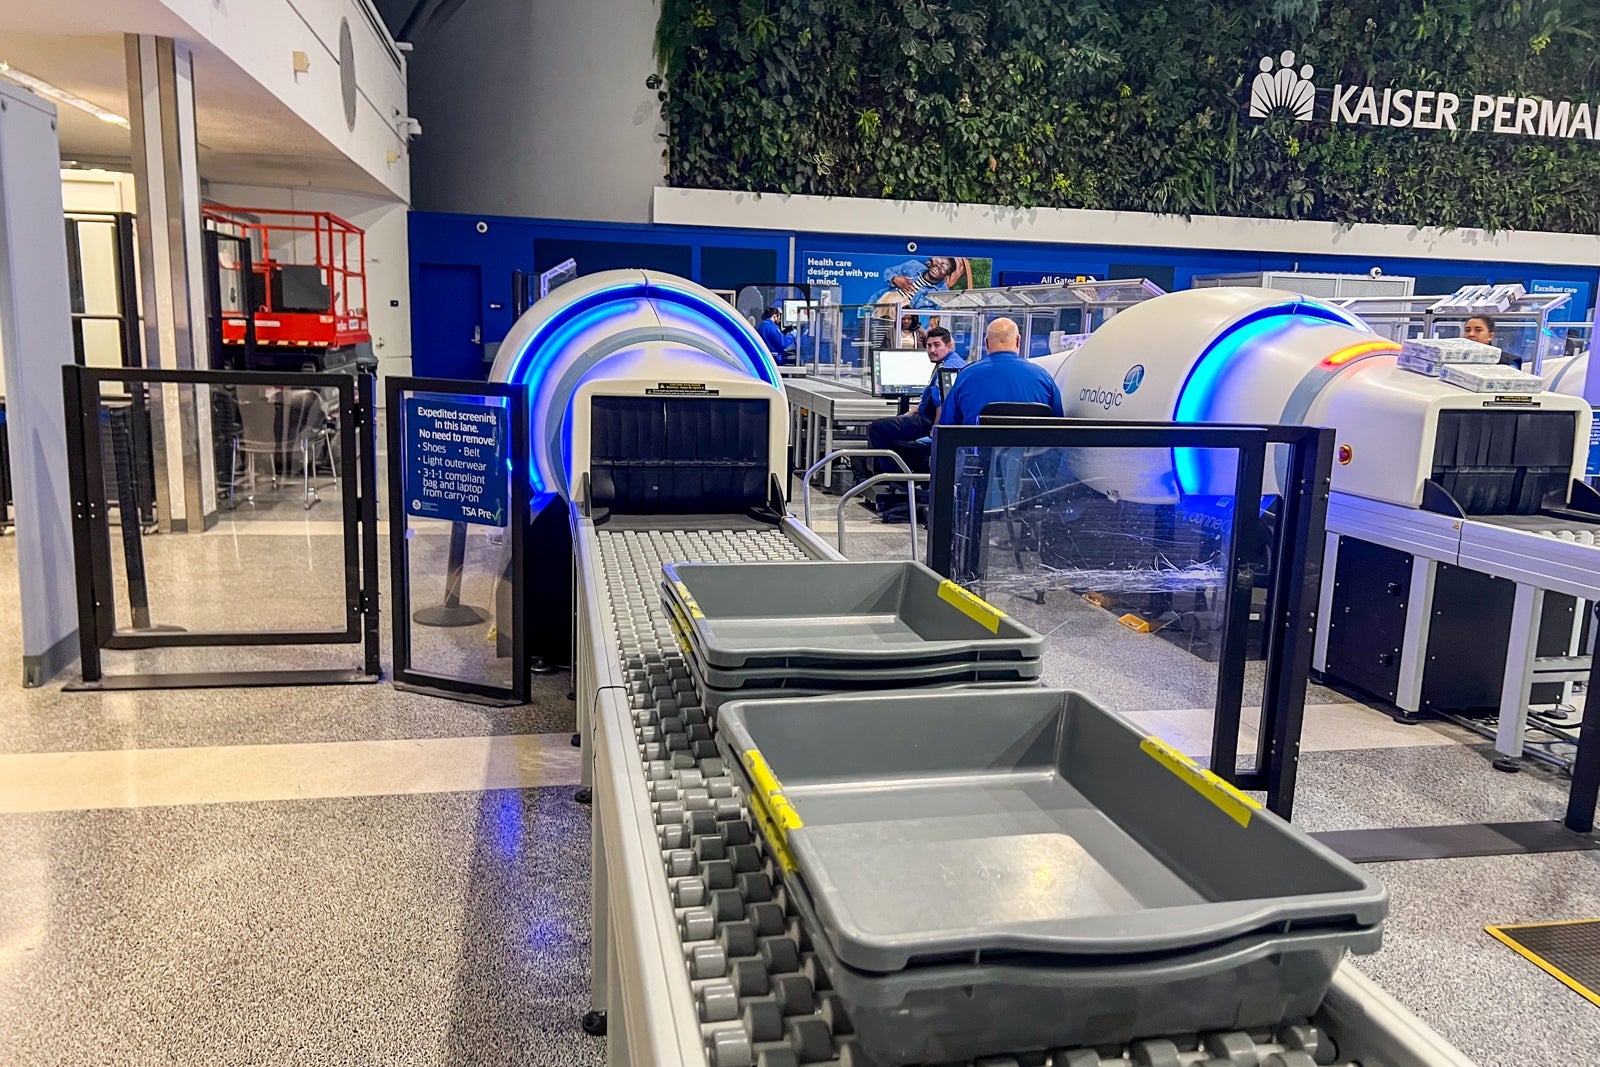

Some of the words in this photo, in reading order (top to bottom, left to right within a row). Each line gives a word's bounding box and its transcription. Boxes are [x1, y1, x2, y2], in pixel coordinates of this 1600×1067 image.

[1331, 84, 1459, 130] KAISER
[807, 258, 834, 267] Health
[807, 267, 844, 277] designed
[845, 269, 863, 277] with
[864, 271, 879, 279] you
[807, 277, 815, 285] in
[816, 277, 839, 286] mind.
[1041, 276, 1052, 284] All
[1534, 284, 1563, 292] Excellent
[1564, 286, 1578, 294] care
[1079, 386, 1123, 410] analogic
[418, 406, 457, 419] Expedited
[458, 411, 497, 425] screening
[444, 420, 459, 431] this
[460, 422, 479, 433] lane.
[419, 428, 430, 438] No
[432, 430, 451, 441] need
[452, 433, 461, 442] to
[462, 435, 496, 446] remove:
[422, 442, 446, 453] Shoes
[463, 446, 480, 457] Belt
[423, 455, 442, 467] Light
[444, 459, 487, 471] outerwear
[423, 468, 442, 479] 3-1-1
[445, 471, 485, 484] compliant
[423, 478, 437, 489] bag
[439, 480, 454, 490] and
[457, 482, 483, 494] laptop
[423, 487, 442, 498] from
[444, 489, 479, 503] carry-on
[461, 506, 477, 517] TSA
[478, 508, 492, 519] Pre
